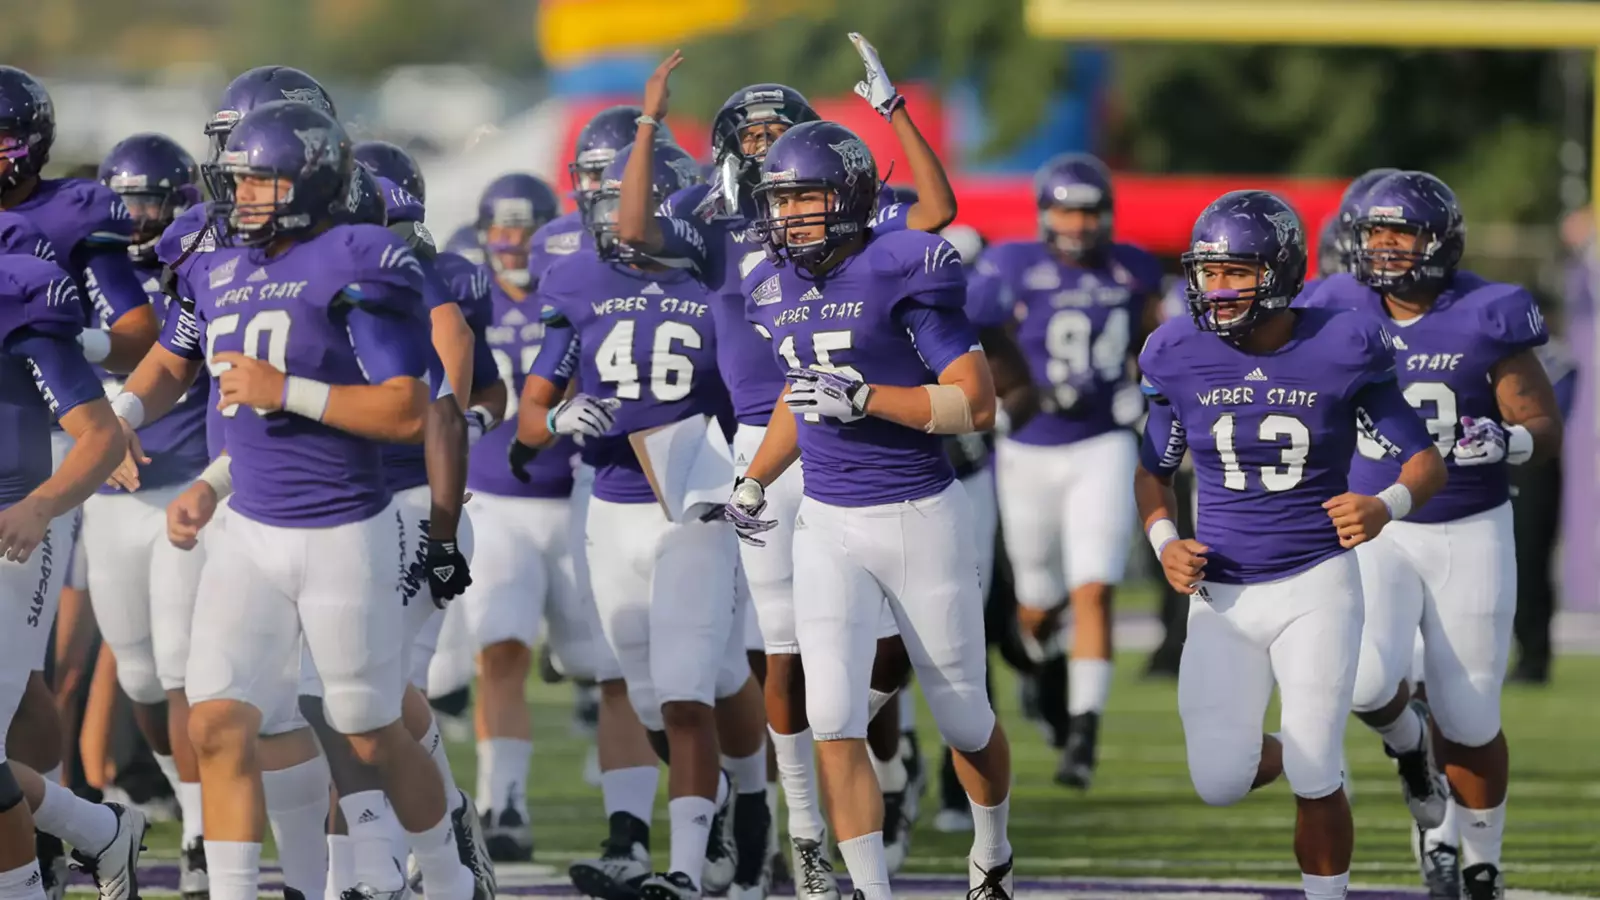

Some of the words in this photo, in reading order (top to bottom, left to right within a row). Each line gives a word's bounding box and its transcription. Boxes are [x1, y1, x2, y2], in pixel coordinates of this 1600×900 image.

[259, 280, 308, 300] STATE
[591, 297, 647, 316] WEBER
[660, 298, 708, 317] STATE
[170, 296, 201, 350] WEB
[773, 305, 810, 327] WEBER
[820, 301, 864, 320] STATE
[595, 320, 702, 401] 46
[1045, 308, 1130, 381] 94
[1406, 353, 1464, 372] STATE
[779, 330, 865, 422] 15
[1196, 387, 1254, 407] WEBER
[1266, 388, 1318, 408] STATE
[1212, 411, 1311, 491] 13
